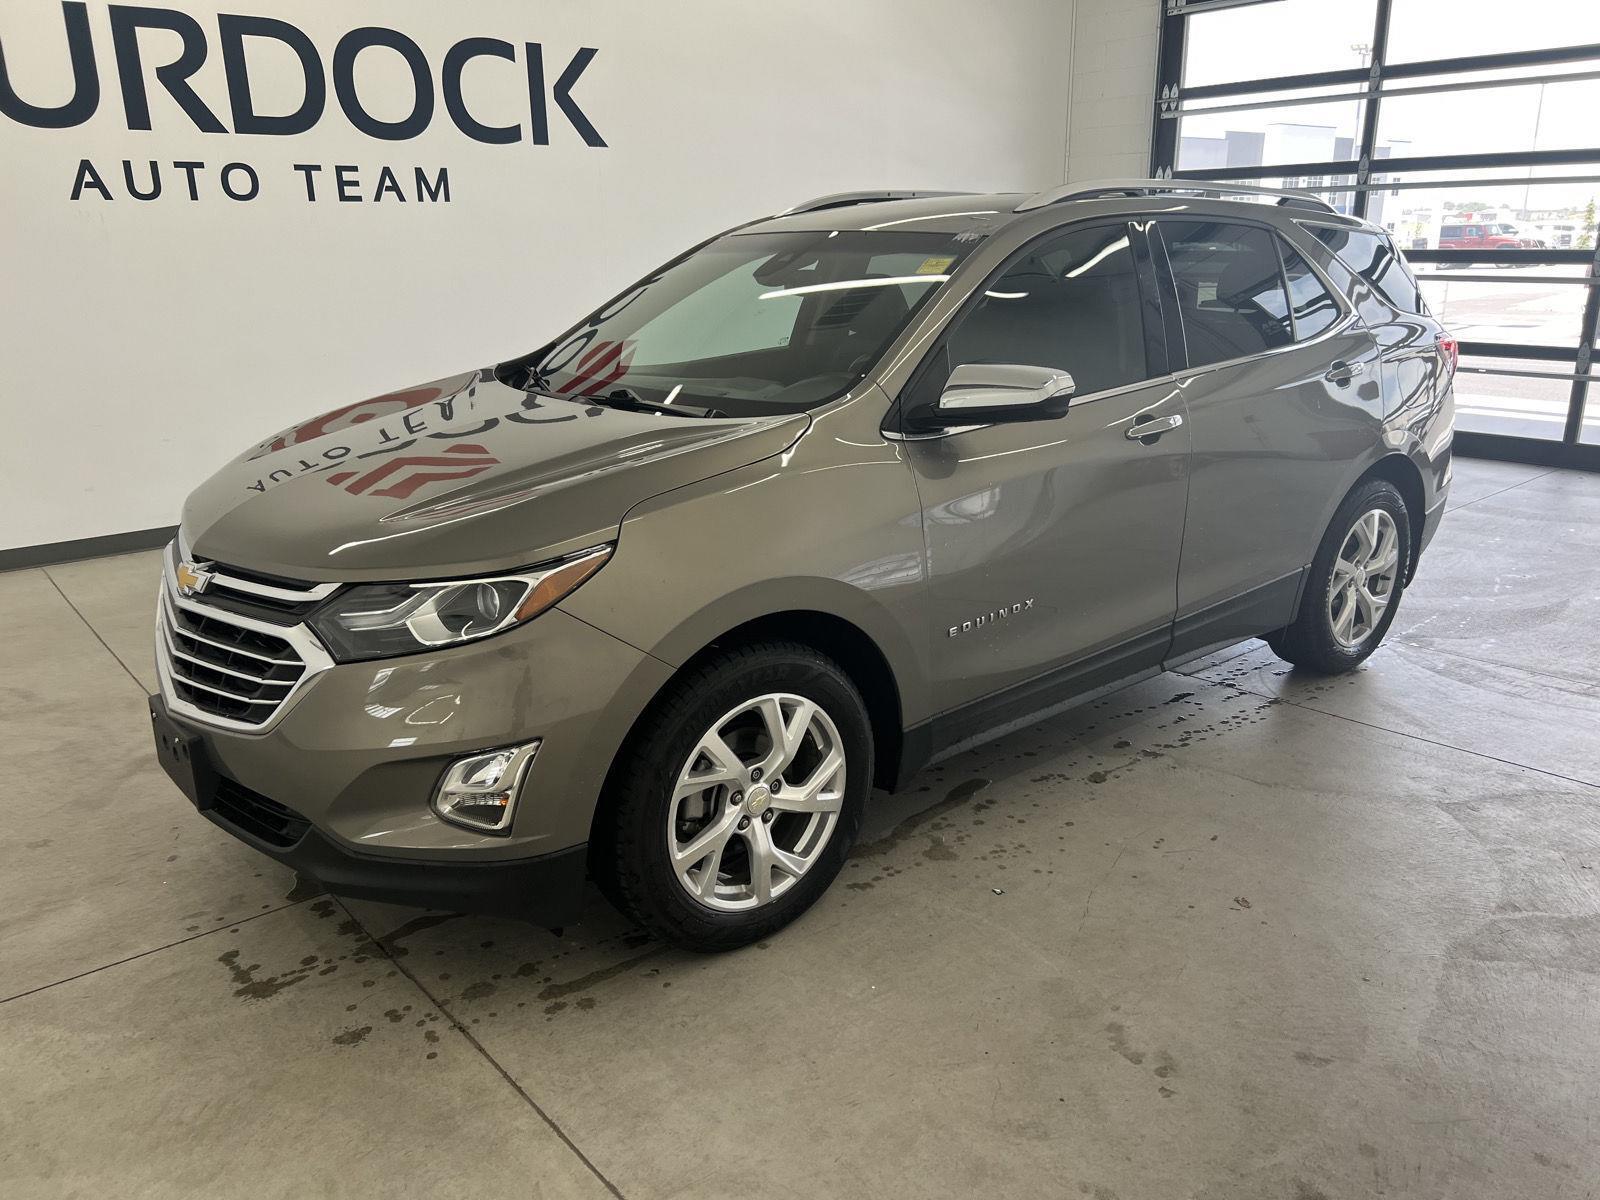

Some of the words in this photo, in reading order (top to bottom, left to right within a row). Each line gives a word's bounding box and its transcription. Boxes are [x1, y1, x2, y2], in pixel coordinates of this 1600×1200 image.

[70, 159, 260, 202] AUTO
[293, 163, 451, 203] TEAM
[948, 598, 1035, 638] EQUINOX
